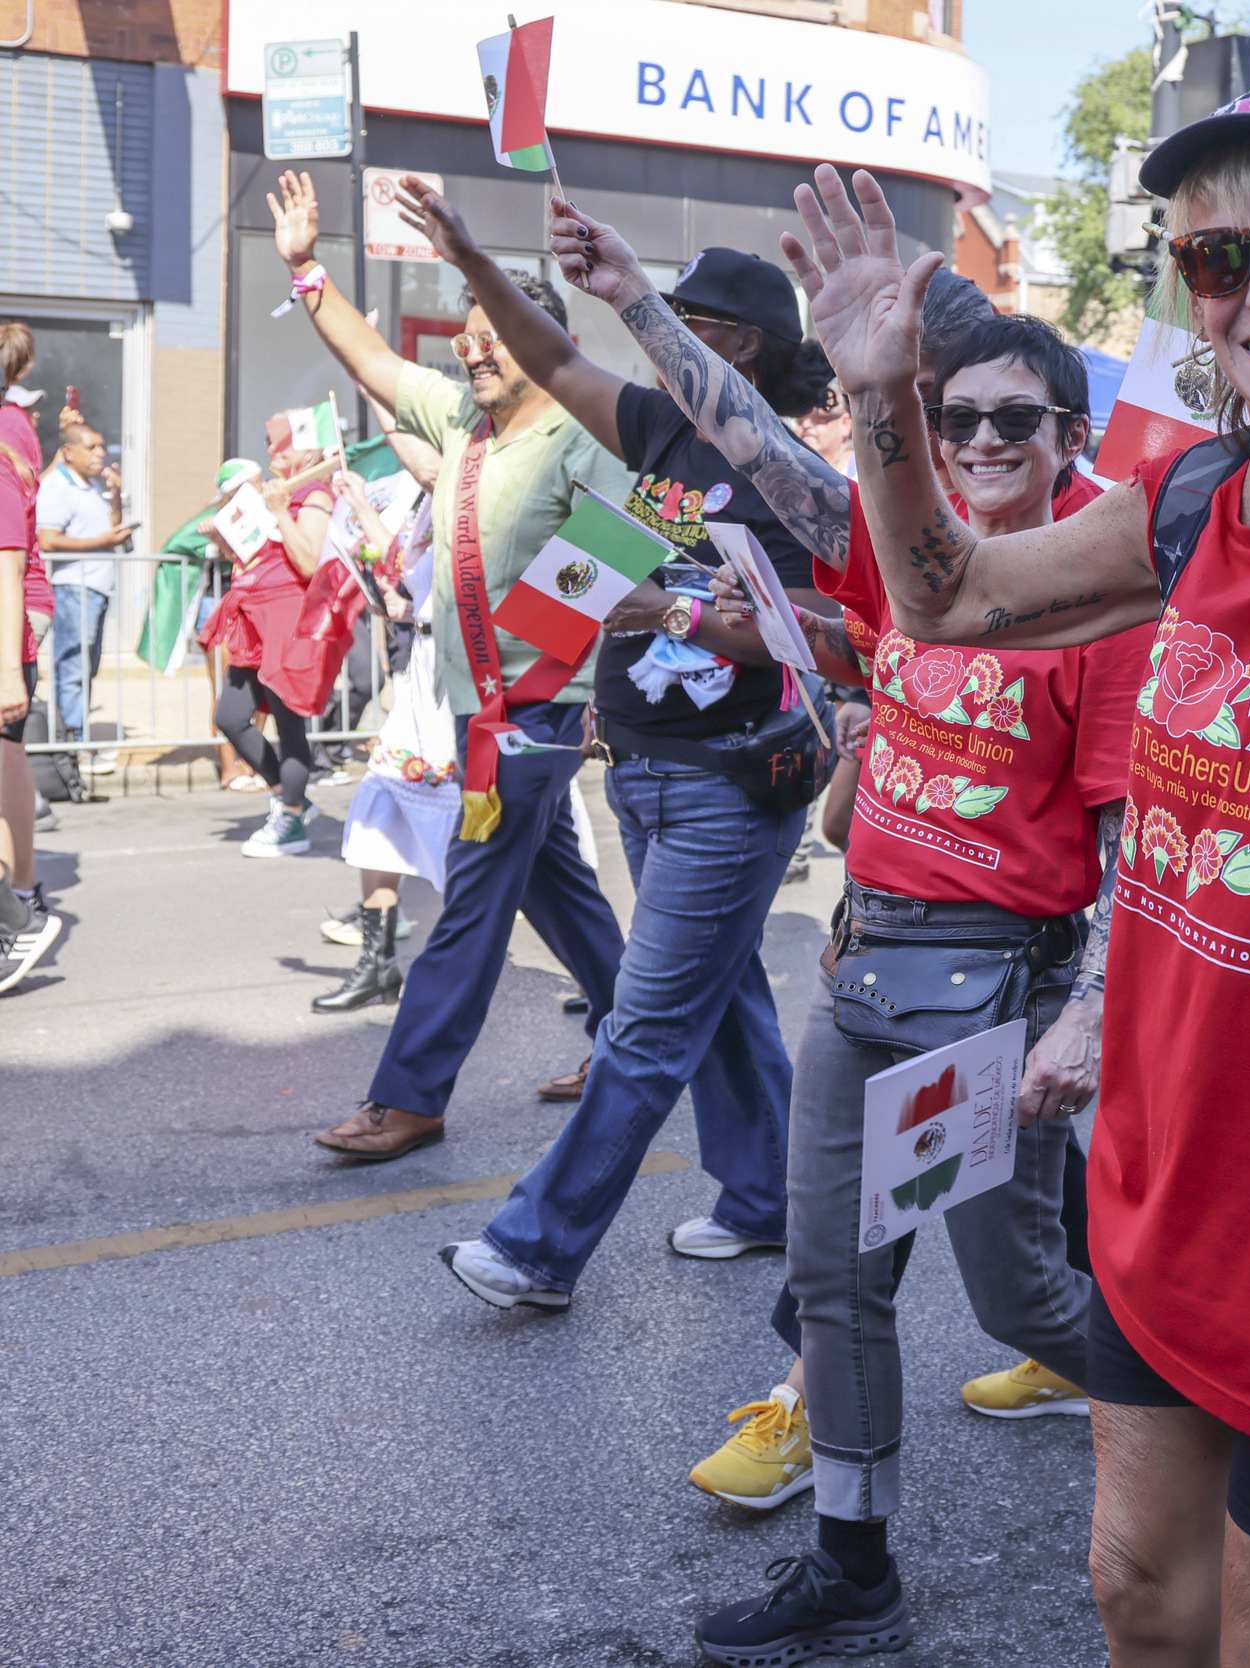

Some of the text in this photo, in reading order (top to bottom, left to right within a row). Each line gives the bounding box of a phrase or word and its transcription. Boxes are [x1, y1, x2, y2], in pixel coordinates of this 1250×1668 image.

[637, 61, 813, 126] BANK
[839, 91, 906, 137] OF
[456, 450, 490, 664] 25th Ward Alderperson
[896, 733, 917, 750] tuya,
[919, 743, 936, 759] mía,
[935, 750, 945, 761] y
[944, 751, 955, 763] de
[955, 755, 986, 775] nosotros
[901, 709, 963, 750] Teachers
[968, 732, 1014, 764] Union
[1143, 726, 1231, 788] Teachers
[1134, 765, 1145, 778] es
[1146, 769, 1164, 791] tuya,
[1166, 778, 1189, 802] mía,
[1191, 791, 1199, 807] y
[1201, 791, 1216, 809] de
[875, 813, 891, 826] NOT
[896, 823, 985, 859] DEPORTATION
[1140, 895, 1163, 915] NOT
[970, 1061, 996, 1167] DÍA DE LA
